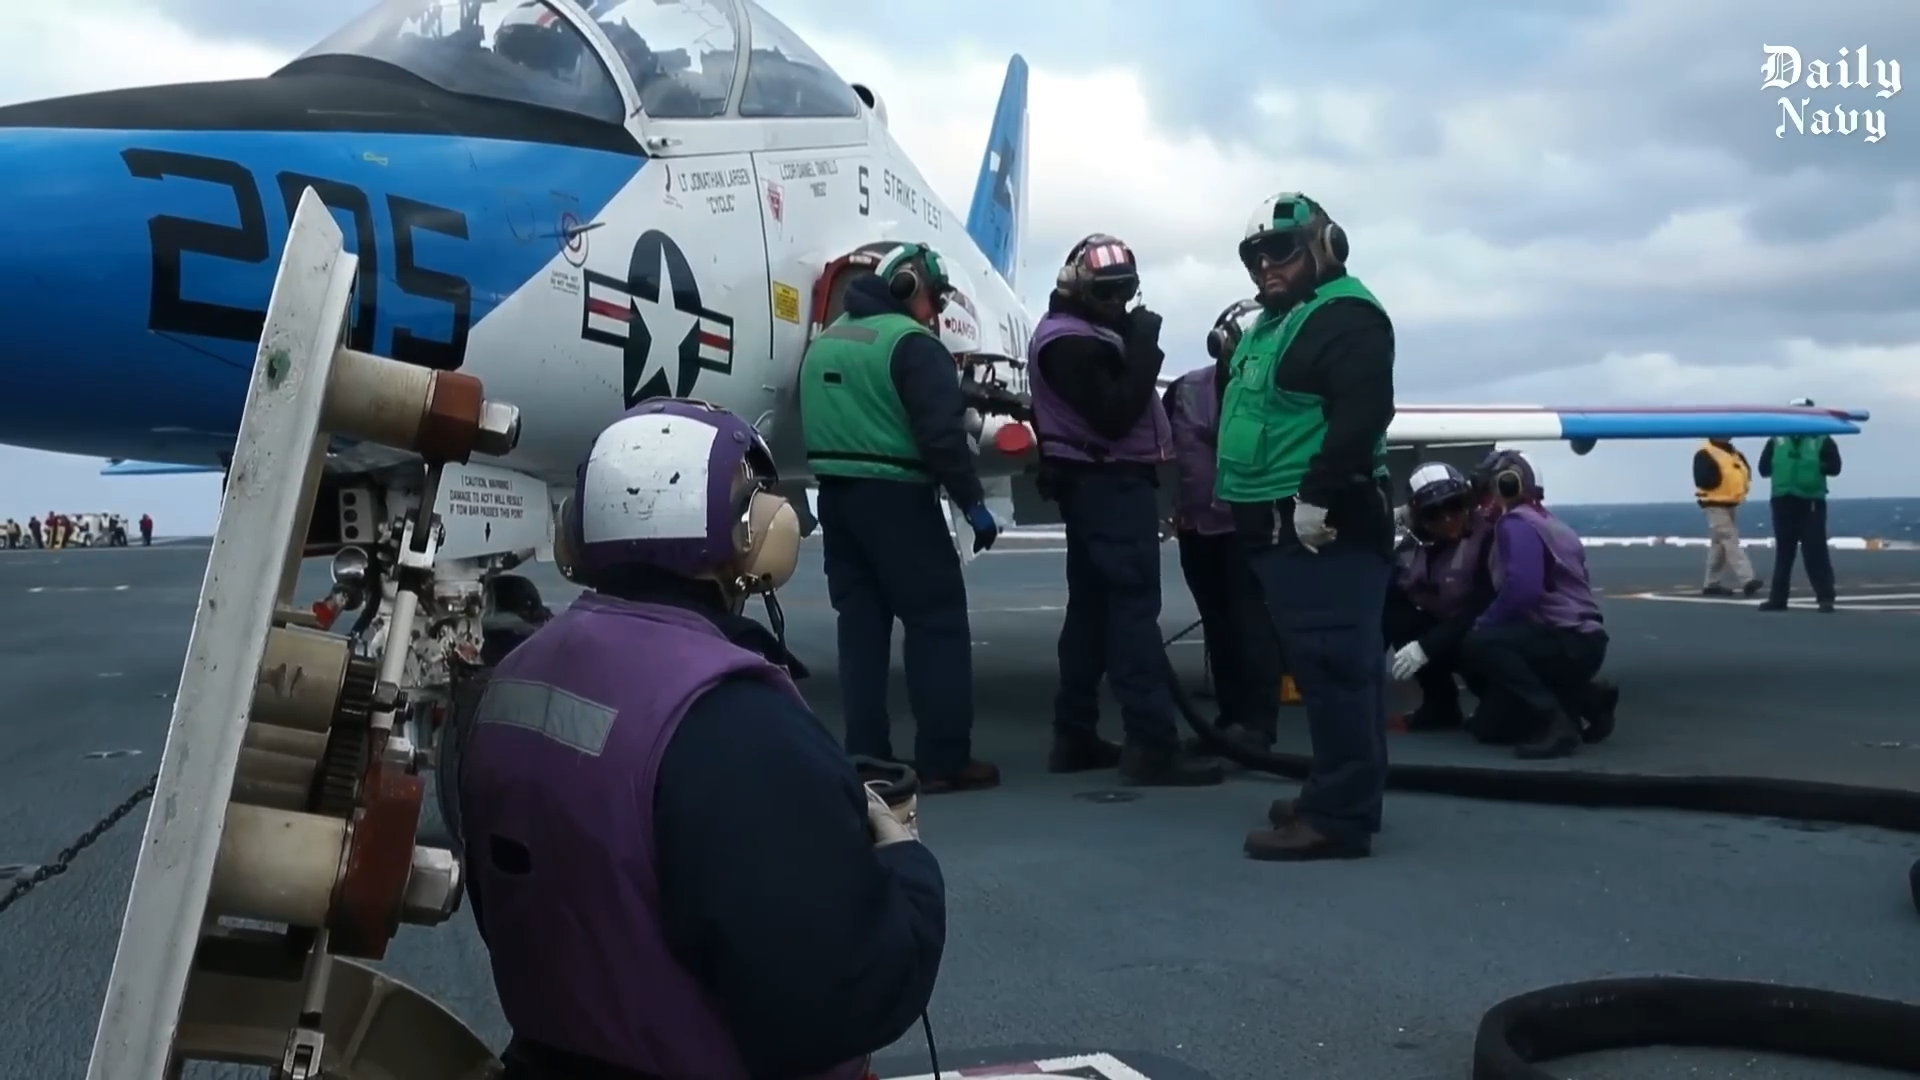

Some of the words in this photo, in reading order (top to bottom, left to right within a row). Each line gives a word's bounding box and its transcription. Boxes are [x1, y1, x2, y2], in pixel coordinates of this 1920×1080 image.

[690, 171, 725, 191] JONATHAN
[724, 168, 751, 187] LARSEN
[884, 168, 917, 215] STRIKE
[922, 197, 942, 233] TEST
[120, 147, 472, 371] 205
[450, 489, 471, 502] DAMAGE
[472, 491, 480, 503] TO
[494, 494, 506, 506] WILL
[469, 505, 479, 516] BAR
